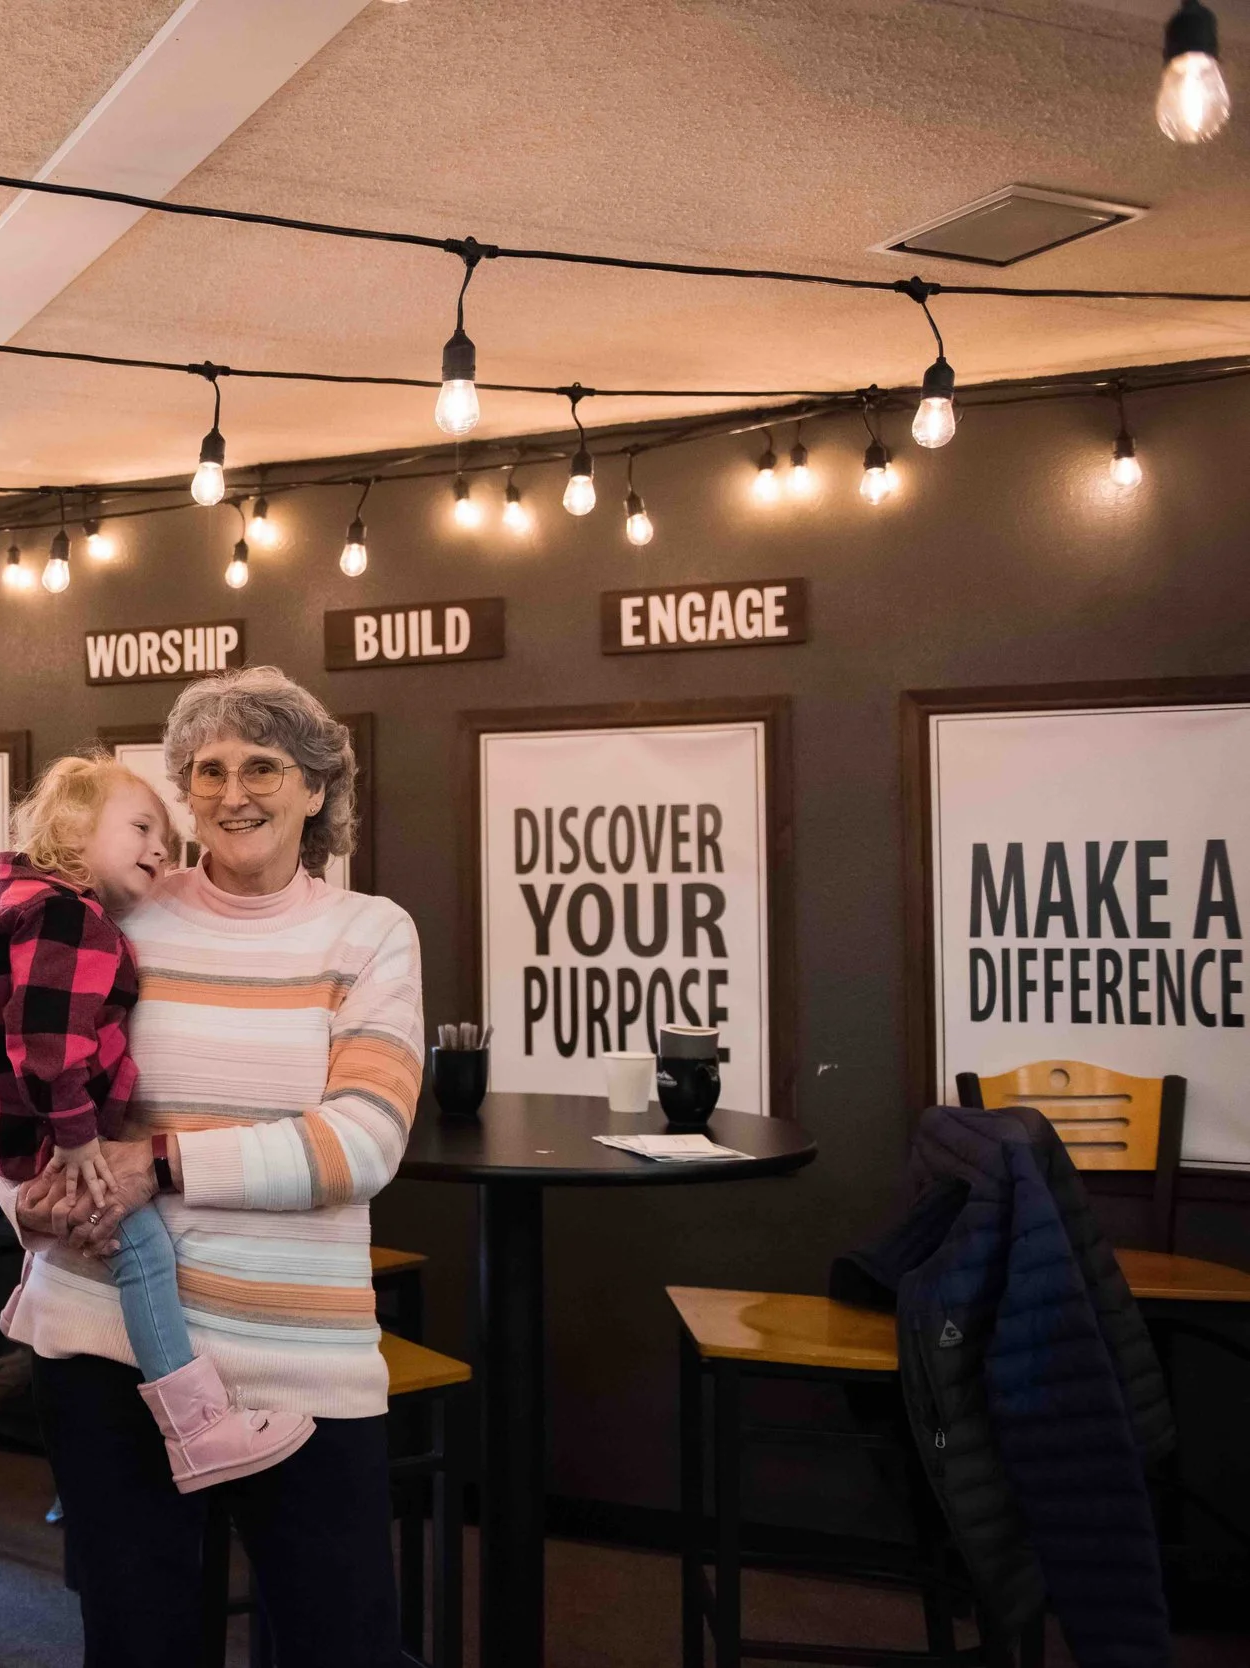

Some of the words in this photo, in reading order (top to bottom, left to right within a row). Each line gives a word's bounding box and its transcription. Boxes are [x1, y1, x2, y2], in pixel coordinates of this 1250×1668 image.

[86, 625, 239, 679] WORSHIP
[354, 607, 470, 662] BUILD
[620, 586, 789, 647] ENGAGE
[514, 803, 725, 875] DISCOVER
[519, 883, 729, 959] YOUR
[969, 840, 1171, 939] MAKE
[1192, 838, 1243, 940] A
[969, 947, 1246, 1028] DIFFERENCE
